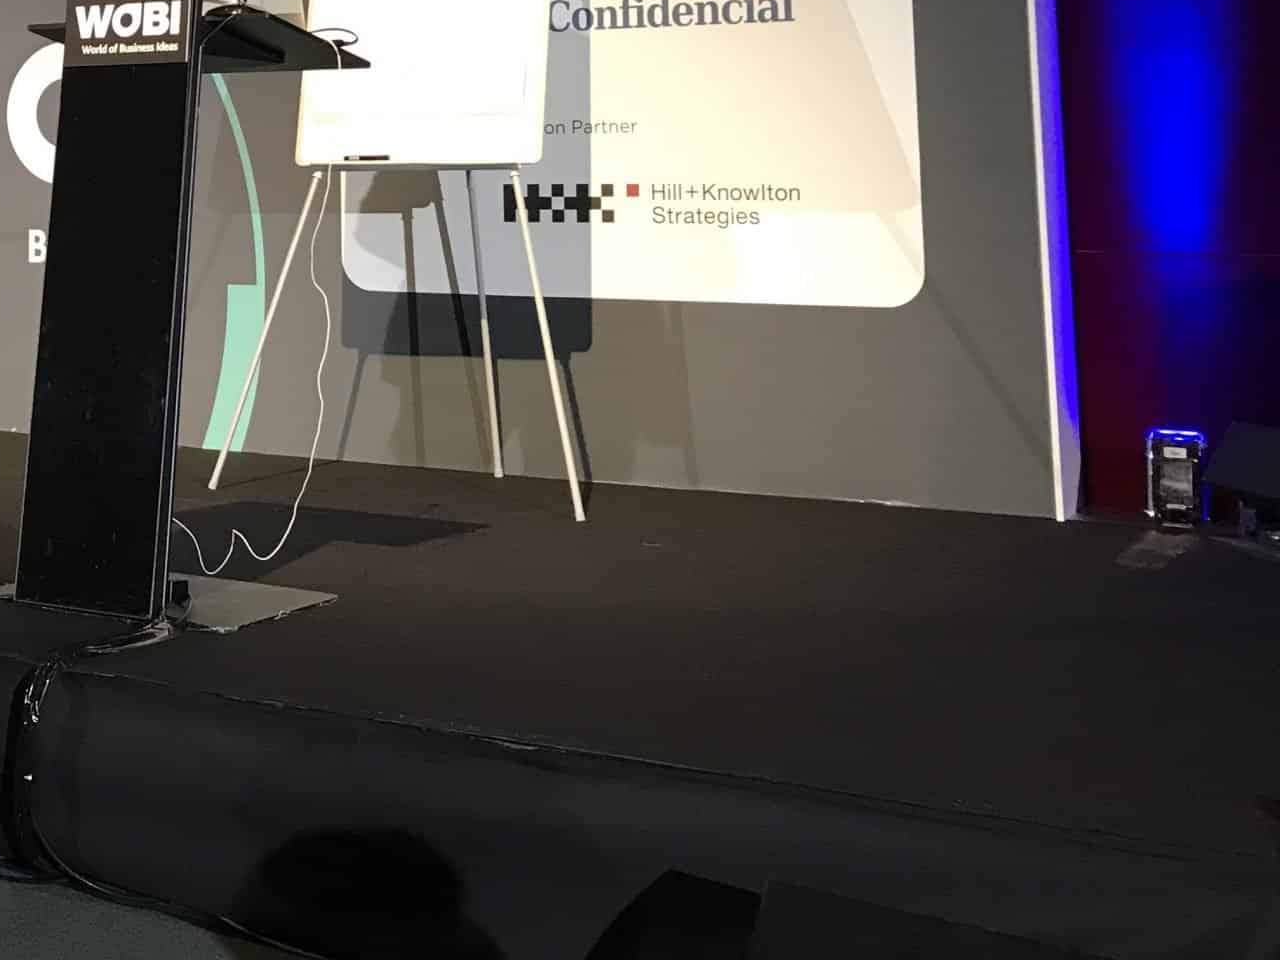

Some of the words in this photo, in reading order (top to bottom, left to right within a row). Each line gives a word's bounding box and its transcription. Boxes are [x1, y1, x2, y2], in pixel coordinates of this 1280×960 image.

[75, 0, 182, 40] WOBI
[82, 43, 107, 55] World
[109, 43, 118, 54] of
[119, 43, 154, 54] Business
[156, 41, 179, 52] Ideas
[571, 119, 638, 135] Partner
[652, 206, 761, 229] Strategies
